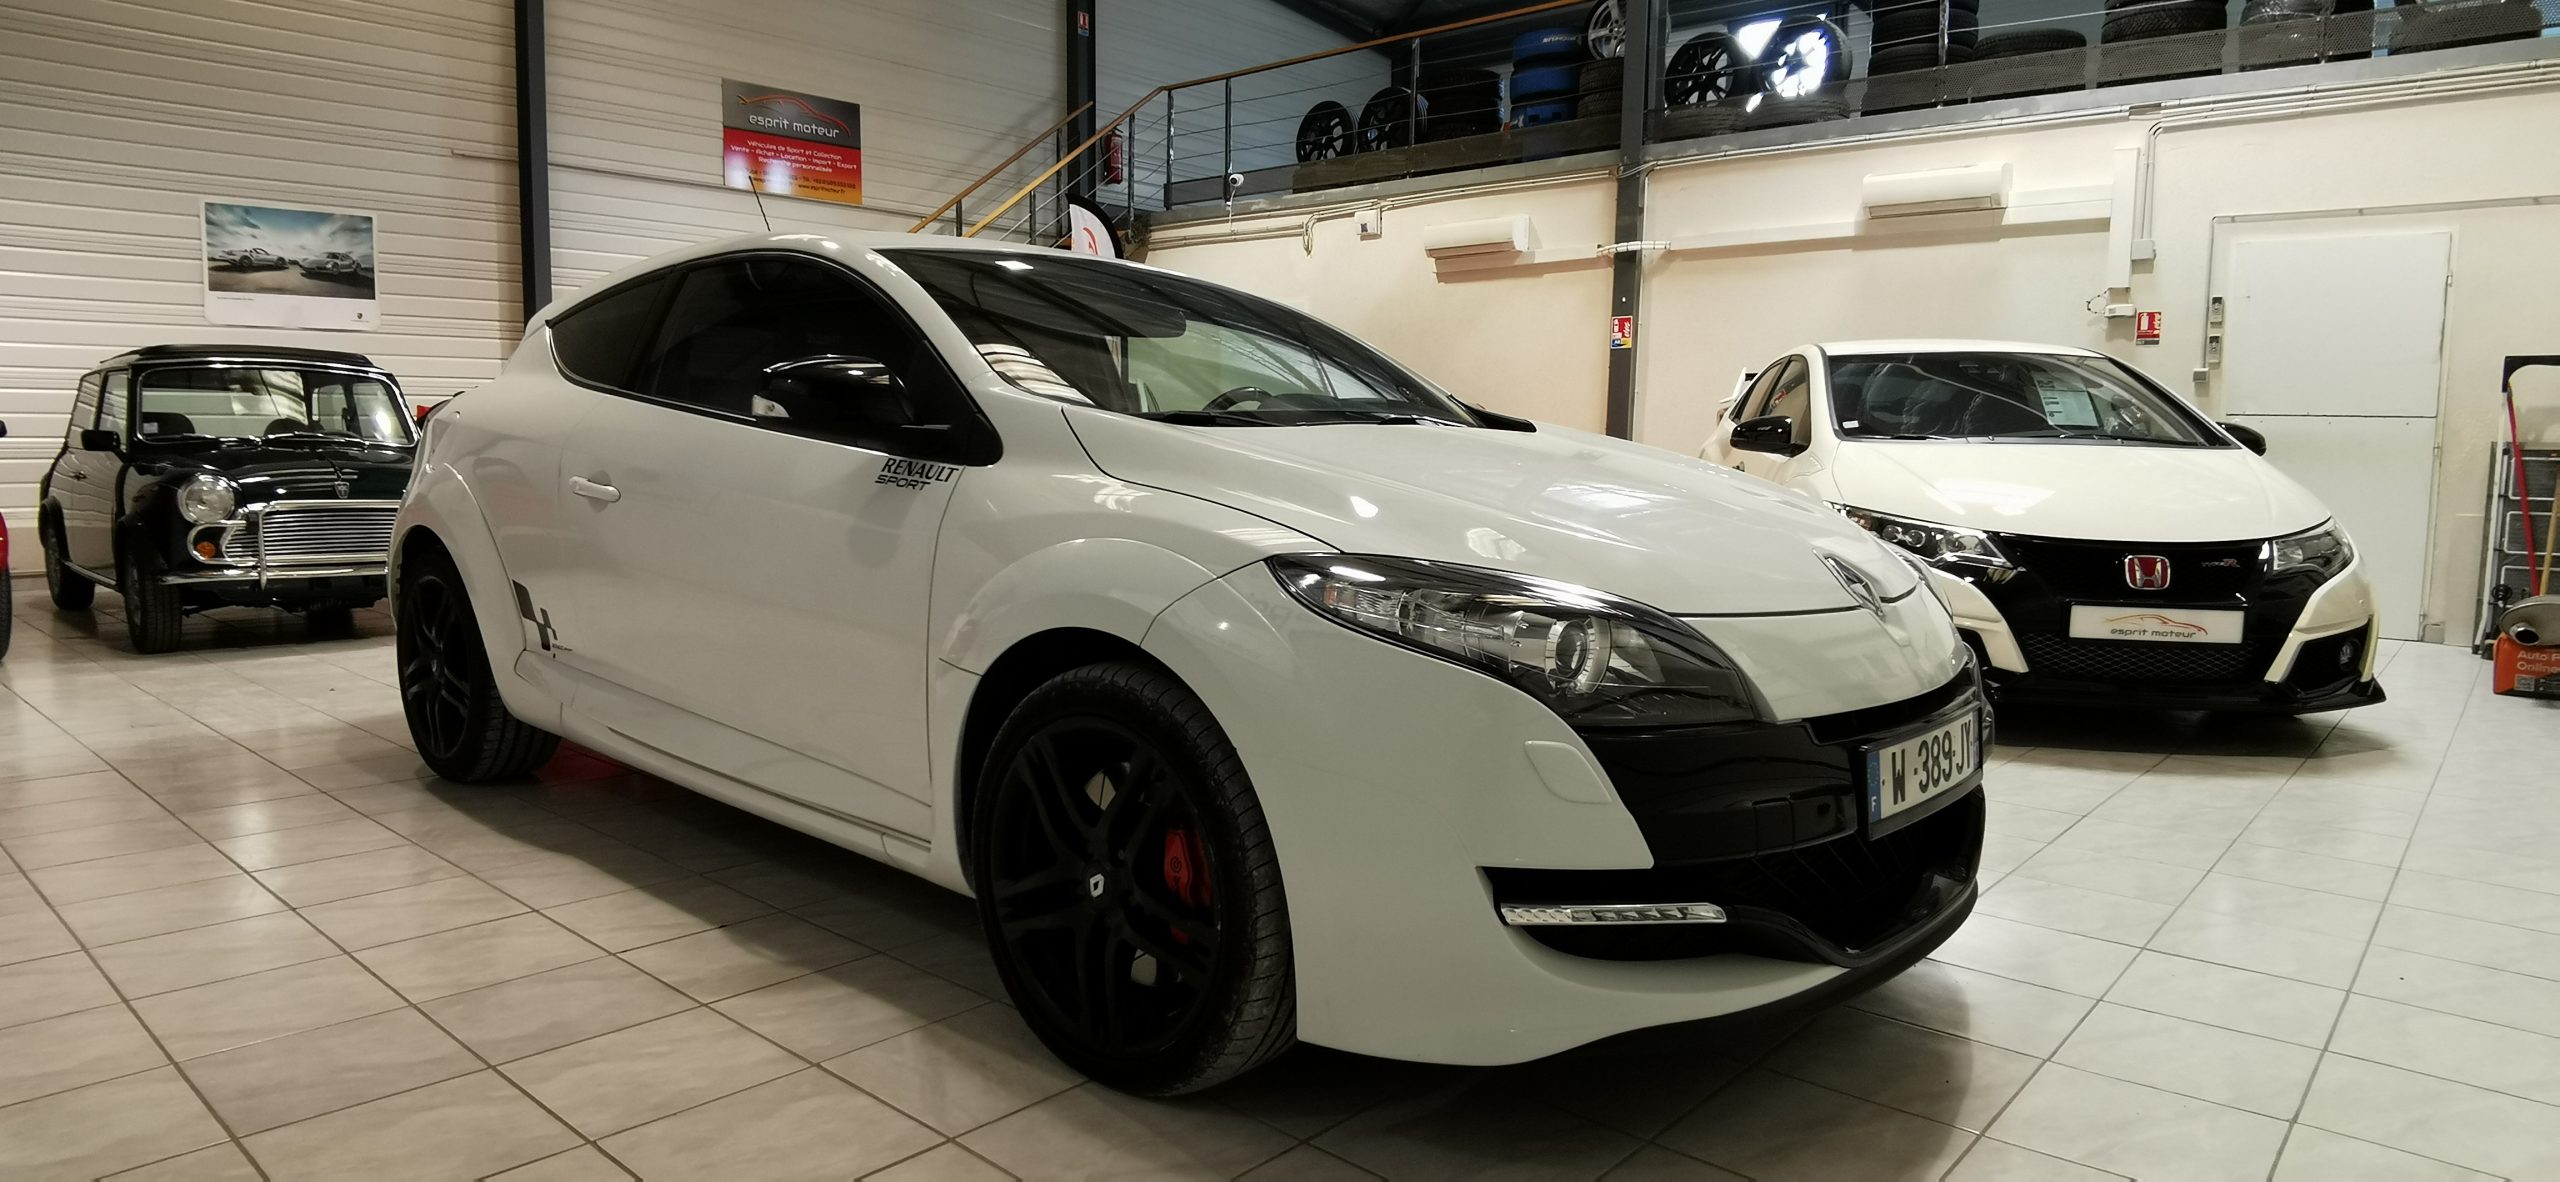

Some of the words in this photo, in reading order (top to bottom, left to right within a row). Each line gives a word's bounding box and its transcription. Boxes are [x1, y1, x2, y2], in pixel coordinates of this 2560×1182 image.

[749, 114, 790, 130] esprit
[793, 120, 840, 138] moteur
[780, 153, 807, 162] Location
[813, 150, 842, 160] Collection
[881, 457, 960, 482] RENAULT
[875, 474, 931, 491] SPORT
[2110, 628, 2148, 637] esprit
[2151, 629, 2196, 638] moteur
[2517, 650, 2549, 660] Auto
